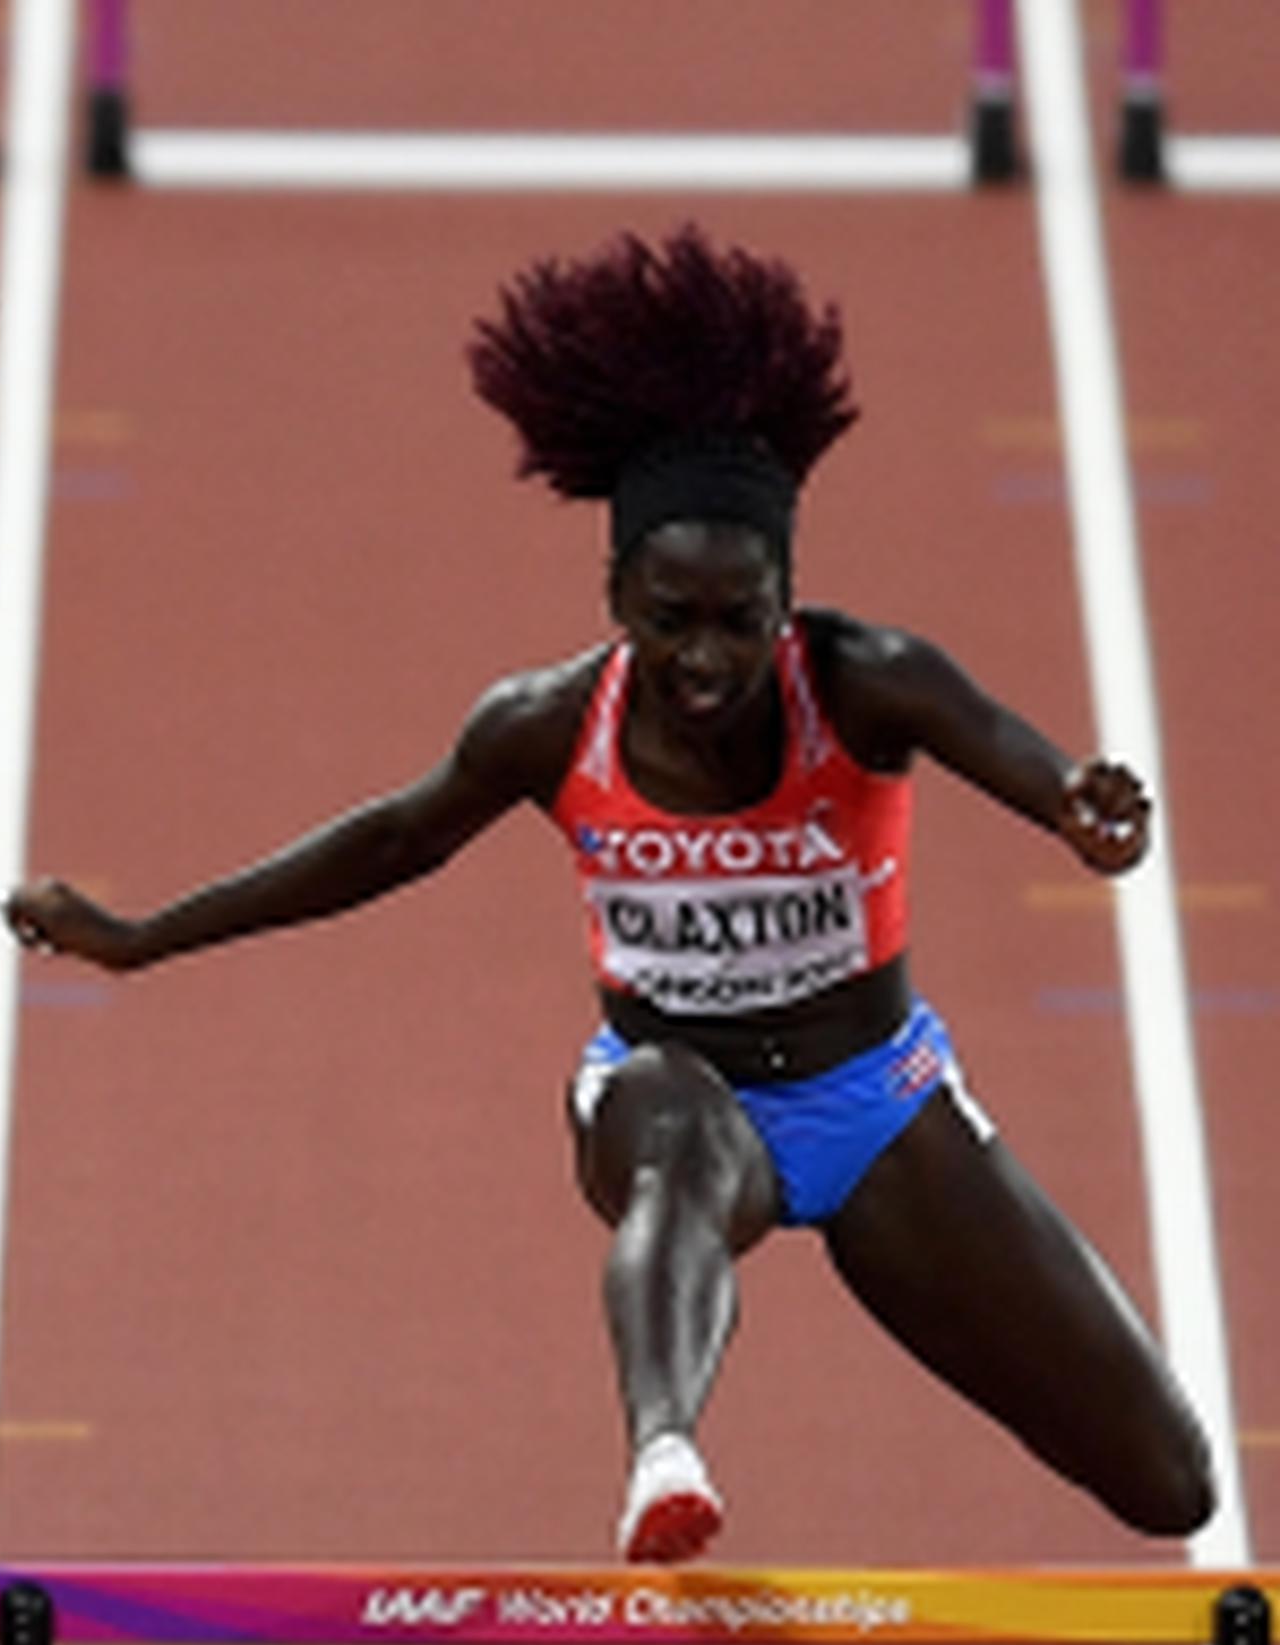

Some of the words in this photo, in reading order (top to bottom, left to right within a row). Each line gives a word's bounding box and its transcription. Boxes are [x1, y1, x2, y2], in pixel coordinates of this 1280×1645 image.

[601, 821, 844, 870] TOYOTA
[360, 1587, 487, 1625] IAAF
[496, 1587, 614, 1626] World
[624, 1587, 910, 1633] Championships
